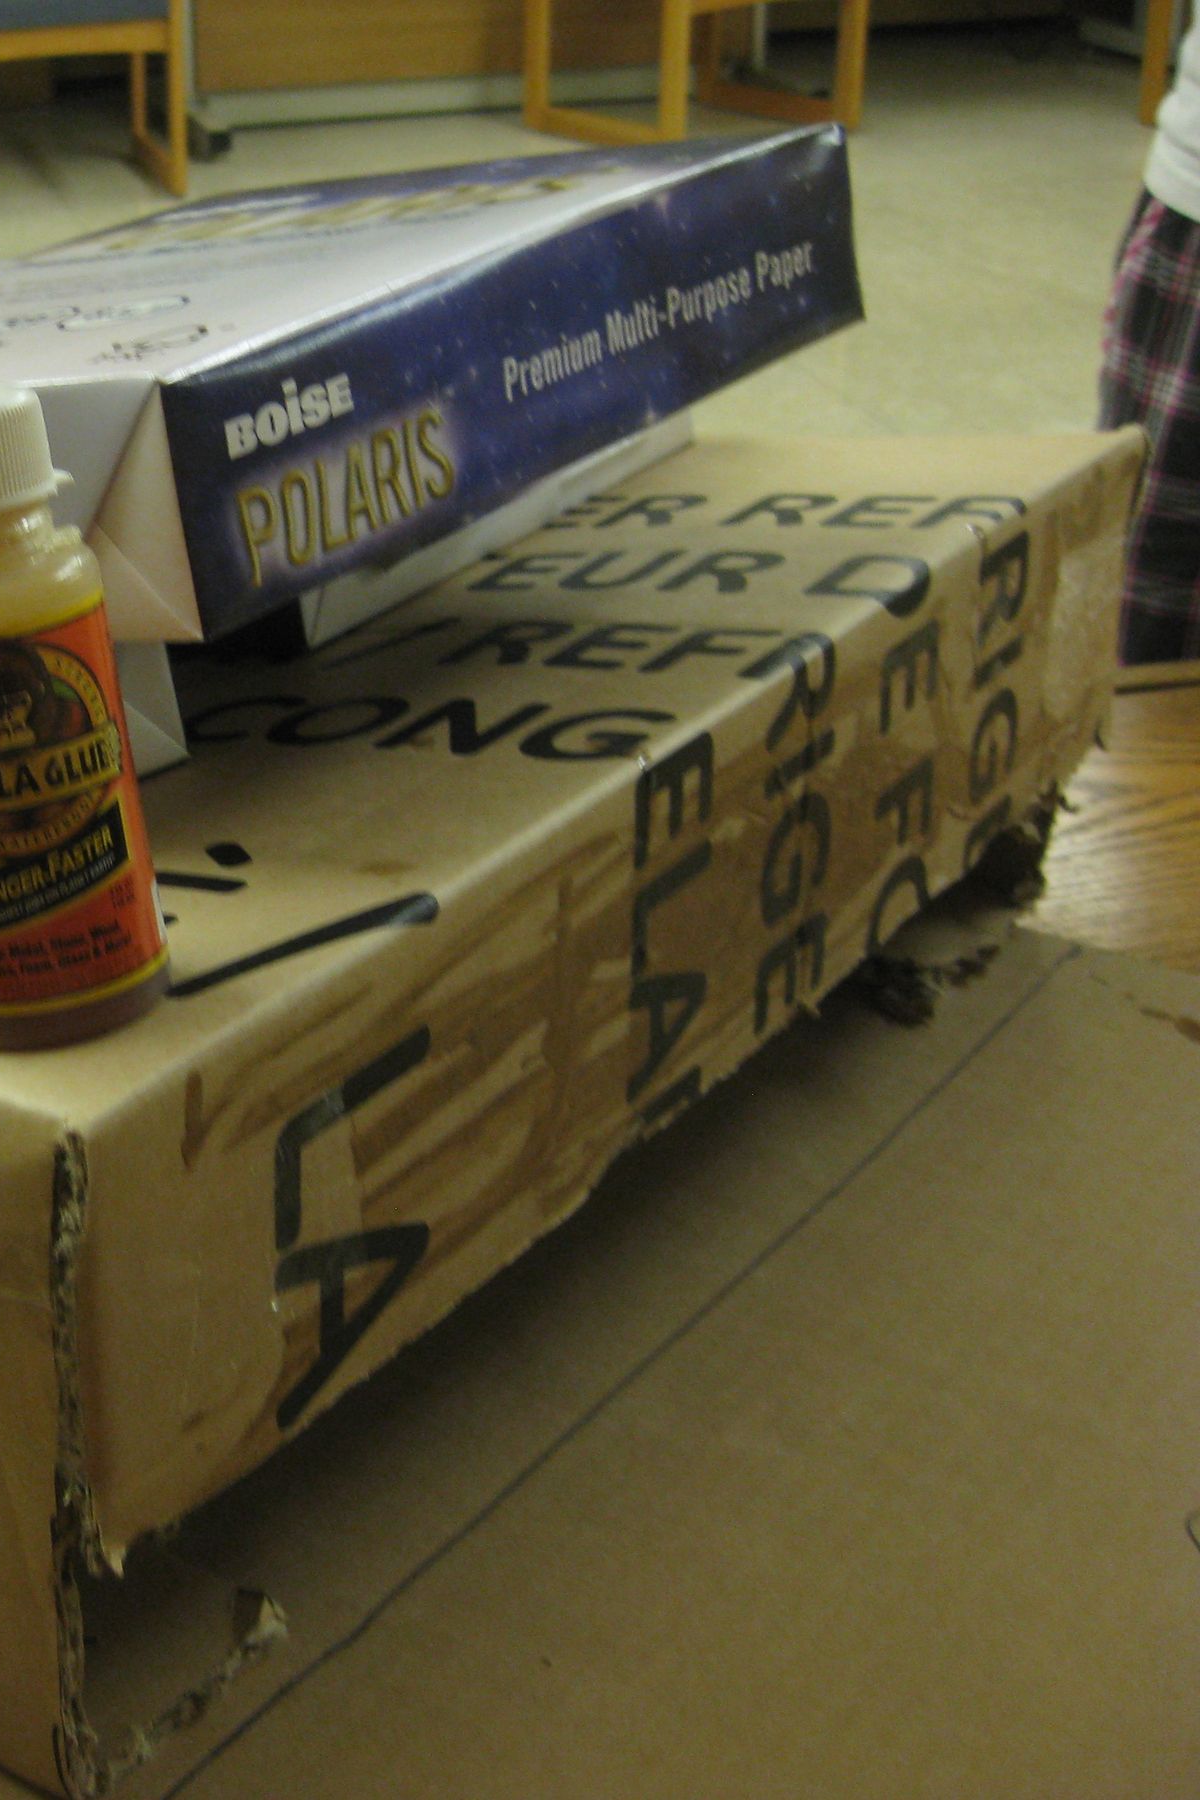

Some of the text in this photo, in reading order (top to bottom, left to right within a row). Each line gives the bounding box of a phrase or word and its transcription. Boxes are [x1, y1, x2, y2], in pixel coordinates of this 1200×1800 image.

[502, 242, 814, 402] Premium Multi-Purpose Paper
[235, 408, 456, 587] POLARIS
[45, 737, 110, 786] GLUE
